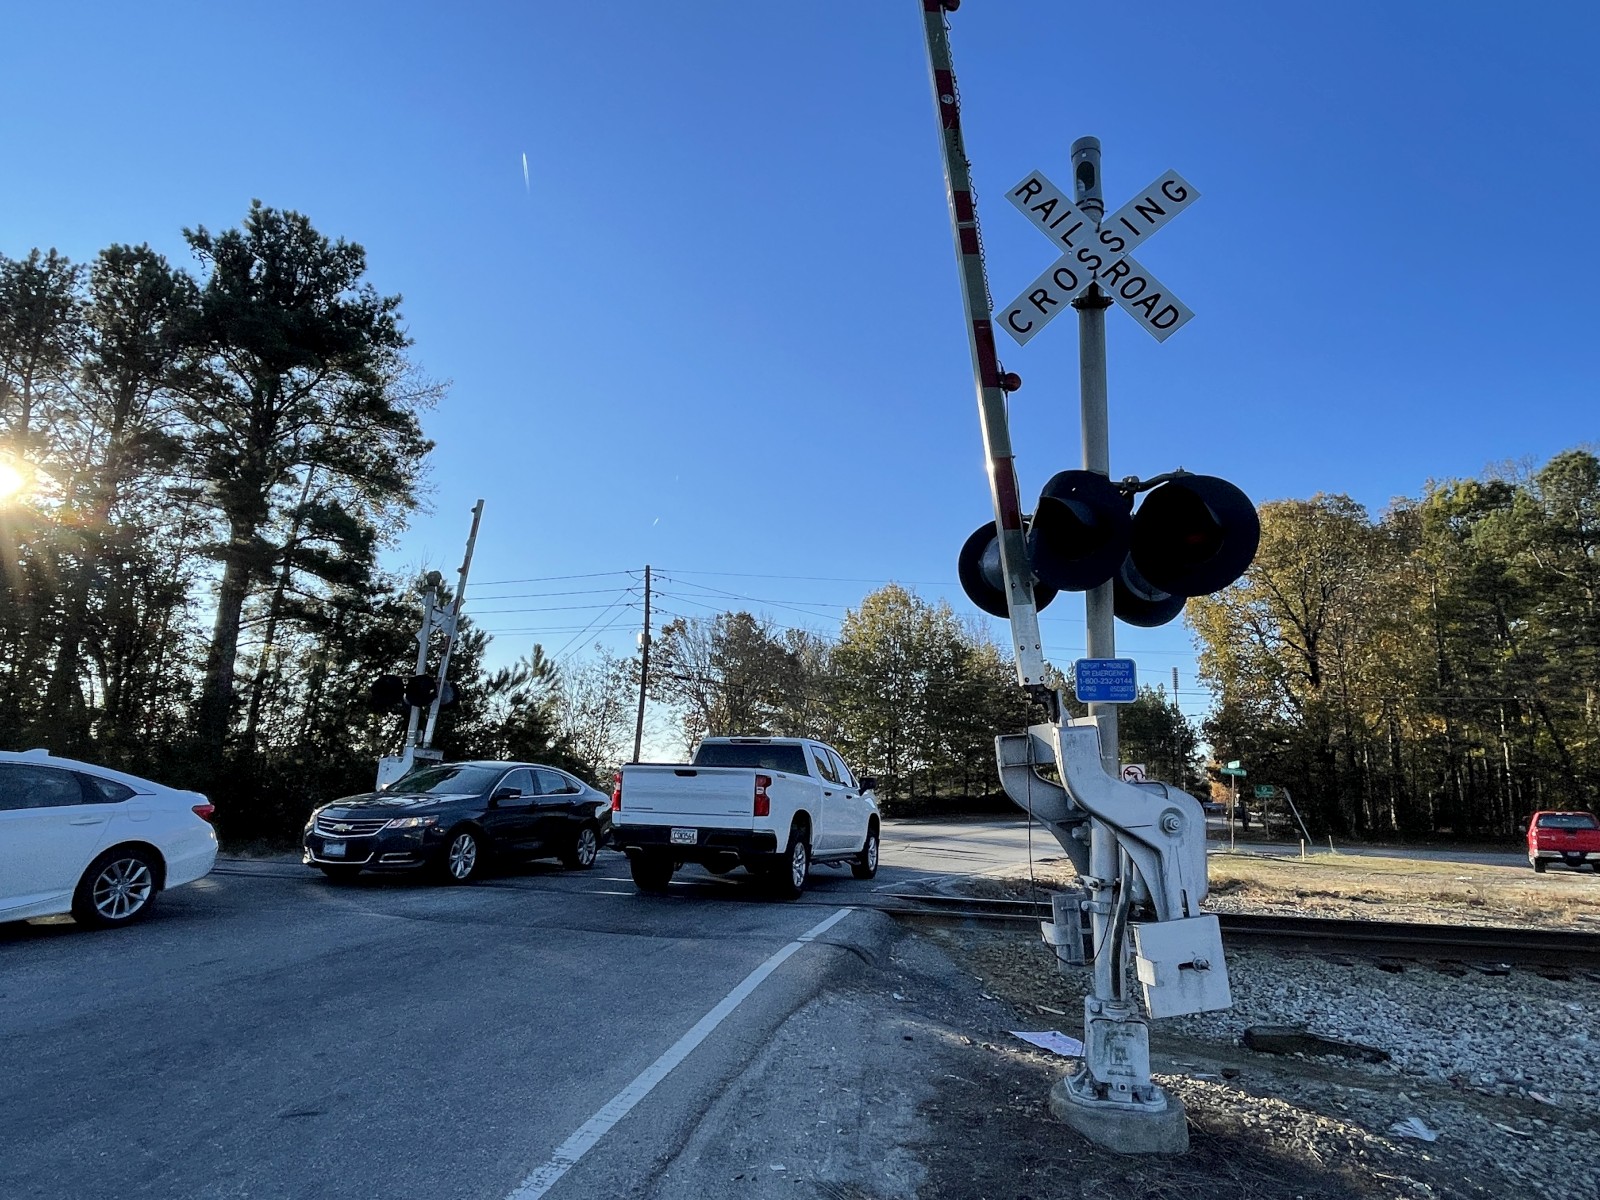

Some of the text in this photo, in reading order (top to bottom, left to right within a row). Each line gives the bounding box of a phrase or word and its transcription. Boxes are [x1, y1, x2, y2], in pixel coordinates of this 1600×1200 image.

[1014, 177, 1084, 248] RAIL
[1008, 180, 1188, 334] CROSSING
[1101, 258, 1180, 330] ROAD
[1079, 677, 1132, 685] 1-800-232-0144
